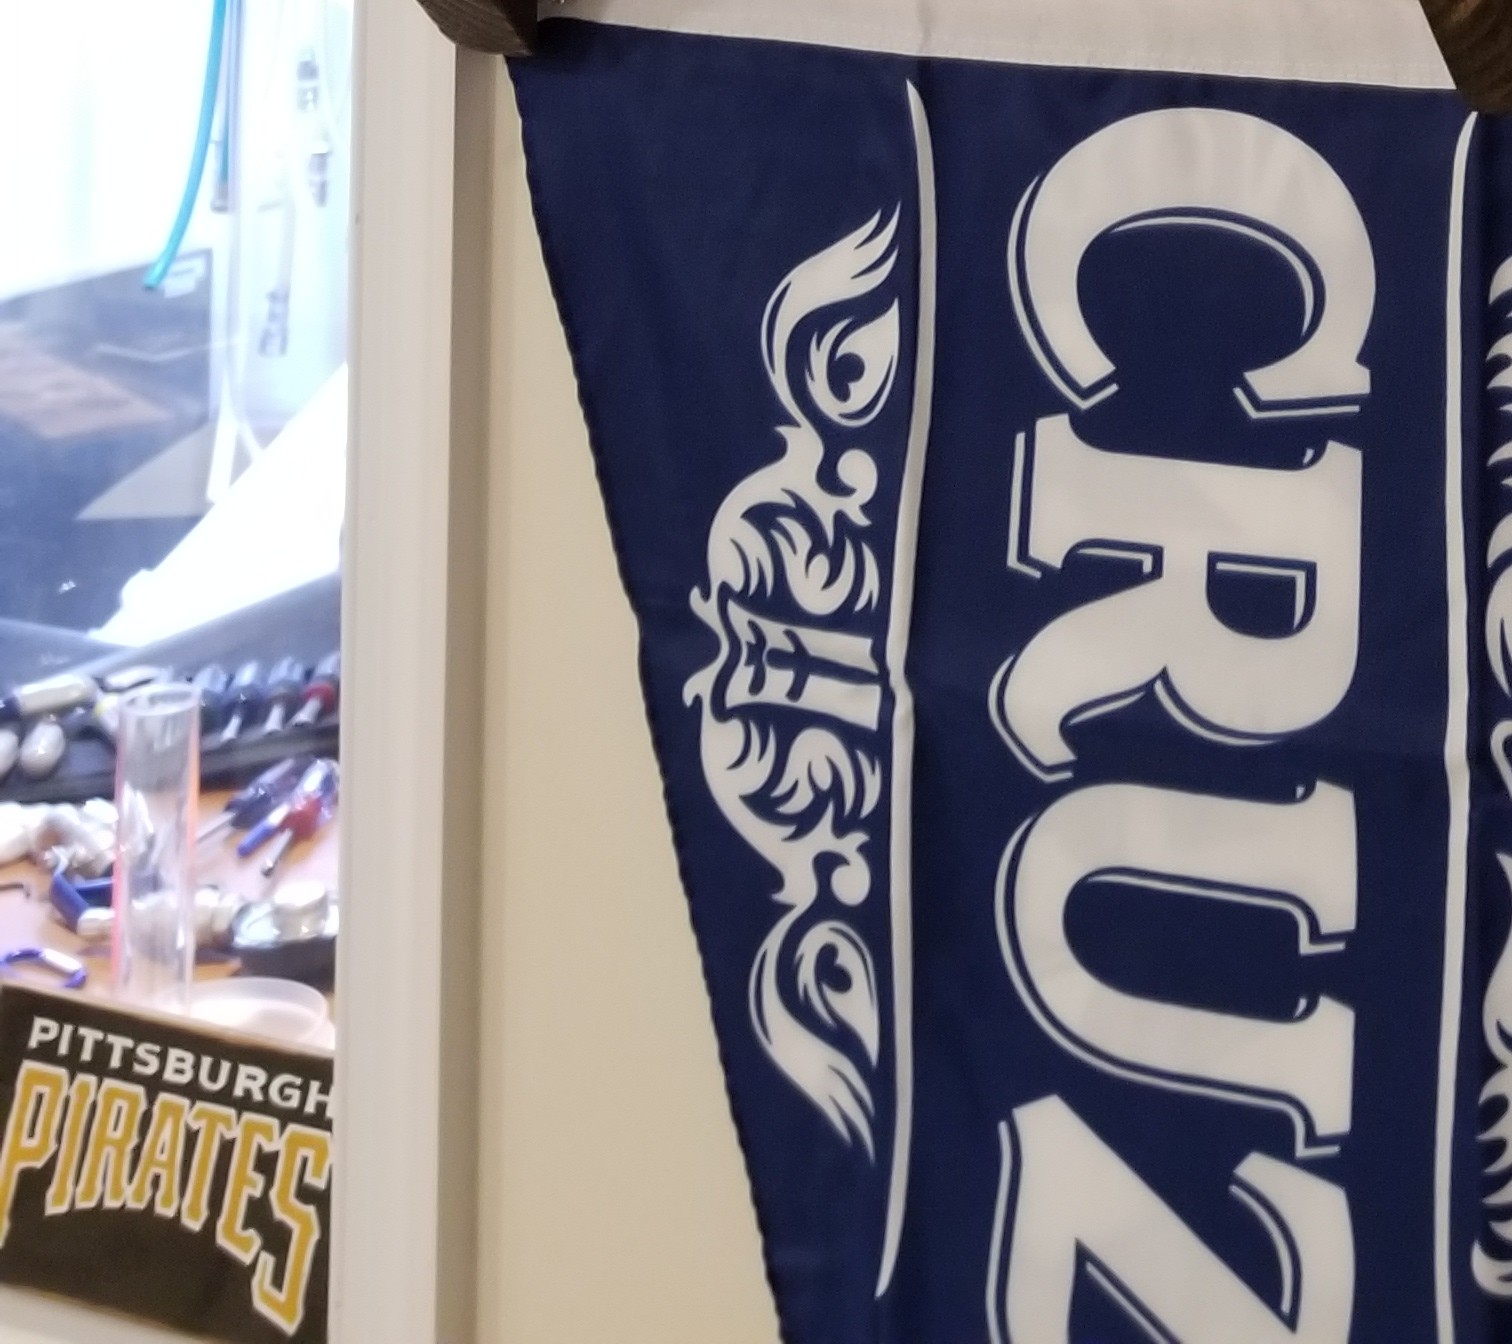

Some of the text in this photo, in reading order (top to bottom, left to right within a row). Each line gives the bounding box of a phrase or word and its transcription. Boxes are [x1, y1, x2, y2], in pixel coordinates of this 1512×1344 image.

[988, 106, 1377, 1344] CRUZ
[0, 1059, 333, 1336] PIRATES
[27, 1015, 333, 1119] PITTSBURGH
